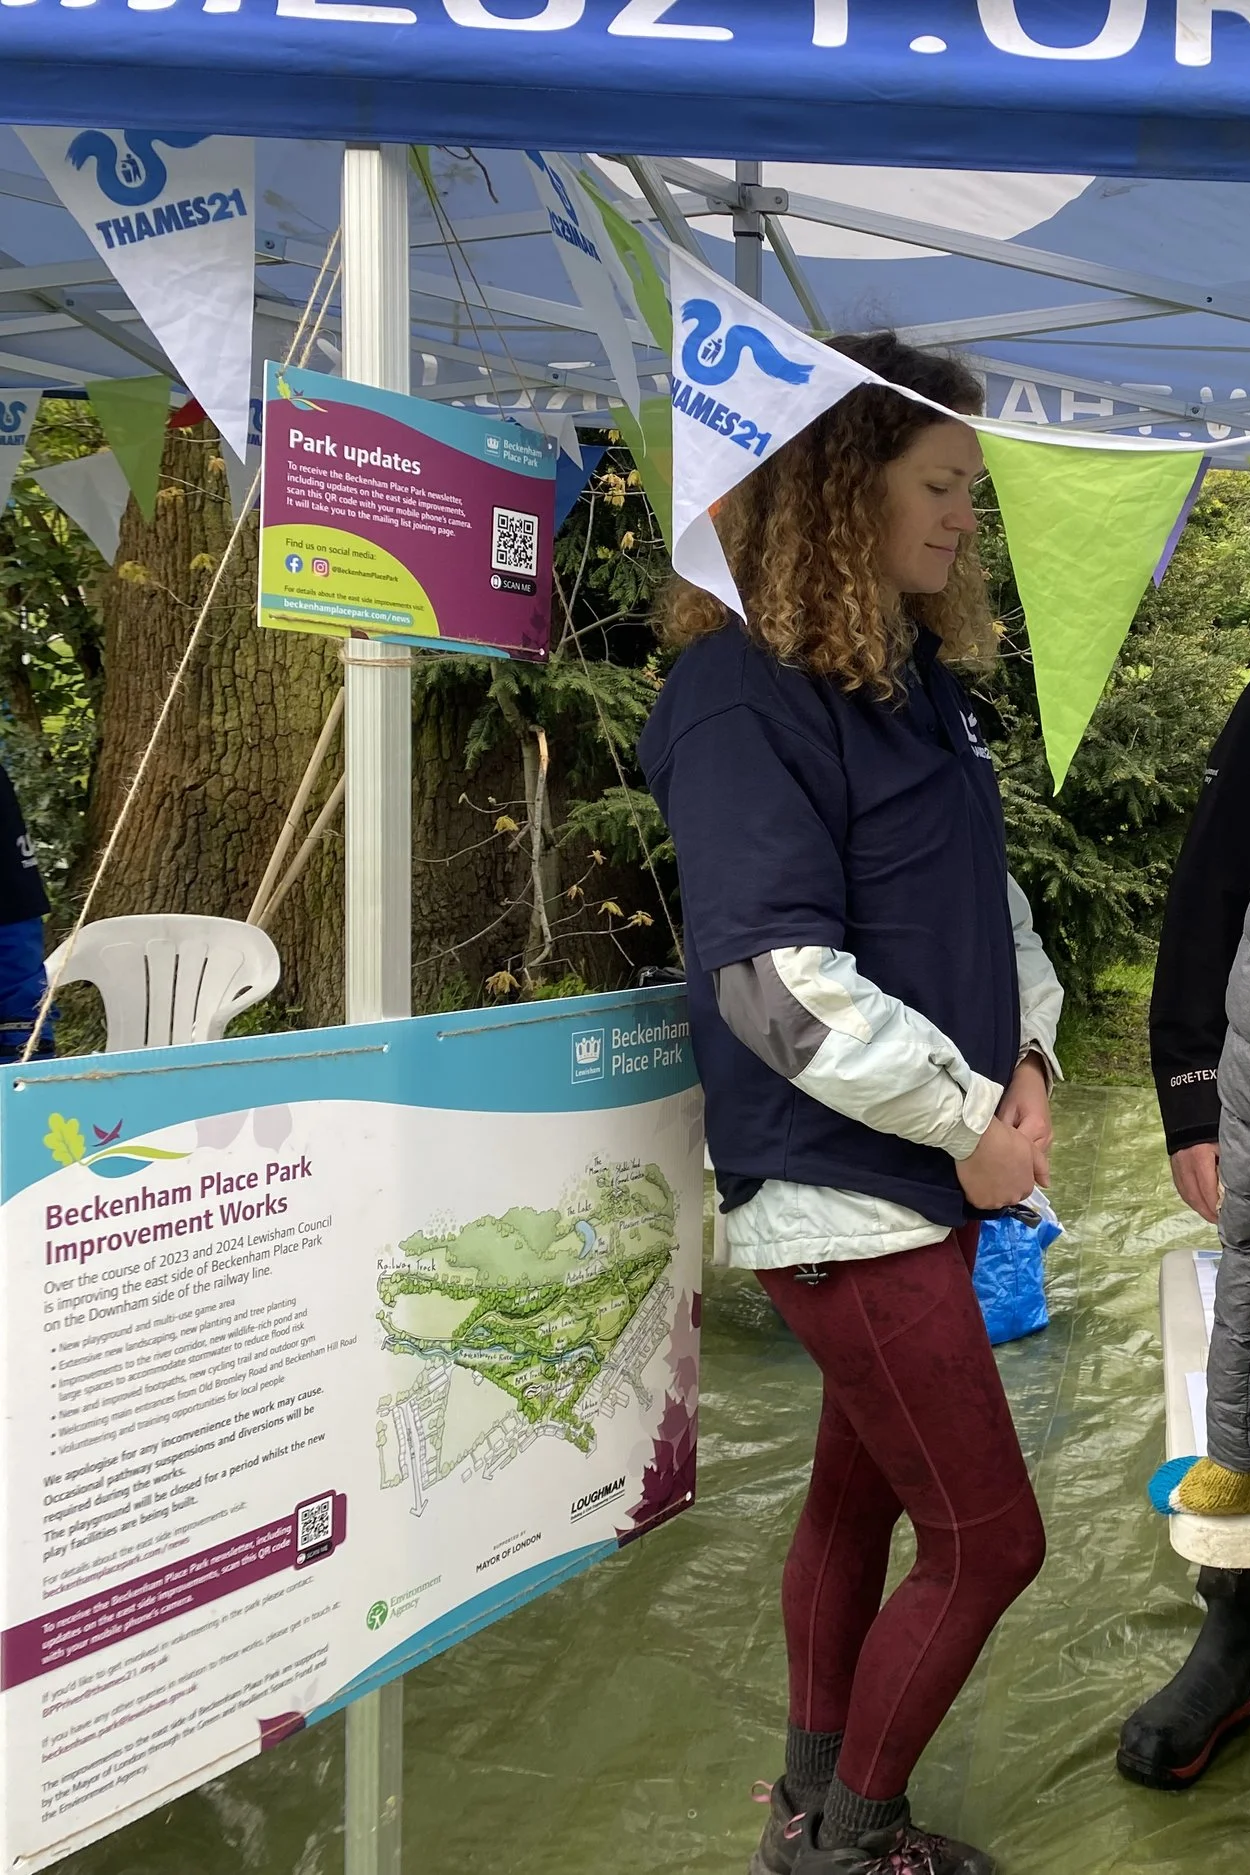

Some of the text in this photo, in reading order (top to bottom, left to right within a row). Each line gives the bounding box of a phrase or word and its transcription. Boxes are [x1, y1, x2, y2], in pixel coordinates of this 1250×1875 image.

[95, 188, 248, 249] THAMES21
[289, 428, 337, 458] Park
[343, 445, 421, 475] updates
[503, 439, 542, 458] Beckenham
[503, 449, 522, 463] Place
[523, 455, 538, 467] Park
[287, 472, 466, 518] including updates on the east side improvements,
[288, 460, 463, 506] To receive the Beckenham Place Park newsletter,
[286, 486, 472, 529] scan this QR code with your mobile phone's camera.
[286, 496, 456, 537] It will take you to the mailing list joining page.
[285, 537, 303, 548] Find
[316, 544, 327, 552] on
[328, 546, 350, 556] social
[351, 550, 376, 560] media:
[331, 566, 398, 582] @BeckenhamPlacePark
[502, 580, 532, 592] SCAN ME
[284, 584, 295, 592] For
[295, 587, 316, 596] details
[317, 590, 335, 598] about
[374, 598, 412, 609] improvements
[284, 598, 410, 624] beckenhamplacepark.com/news
[612, 1019, 689, 1049] Beckenham
[576, 1066, 600, 1078] Lewisham
[612, 1043, 682, 1076] Place Park
[1170, 1069, 1217, 1087] GORE-TEX
[47, 1155, 312, 1230] Beckenham Place Park
[578, 1200, 592, 1214] Lake
[47, 1193, 288, 1265] Improvement Works
[43, 1214, 332, 1294] Over the course of 2023 and 2024 Lewisham Council
[44, 1234, 322, 1313] is improving the east side of Beckenham Place Park
[377, 1258, 436, 1274] Railway Track
[43, 1266, 272, 1332] on the Downham side of the railway line.
[43, 1386, 324, 1487] We apologise for any inconvenience the work may cause.
[43, 1405, 315, 1506] Occasional pathway suspensions and diversions will be
[43, 1432, 325, 1542] The playground will be closed for a period whilst the new
[43, 1467, 186, 1524] required during the works.
[571, 1476, 625, 1514] LOUGHMAN
[42, 1496, 198, 1563] play facilities are being built.
[476, 1532, 542, 1573] MAYOR OF LONDON
[390, 1575, 442, 1608] Environment
[390, 1597, 420, 1619] Agency
